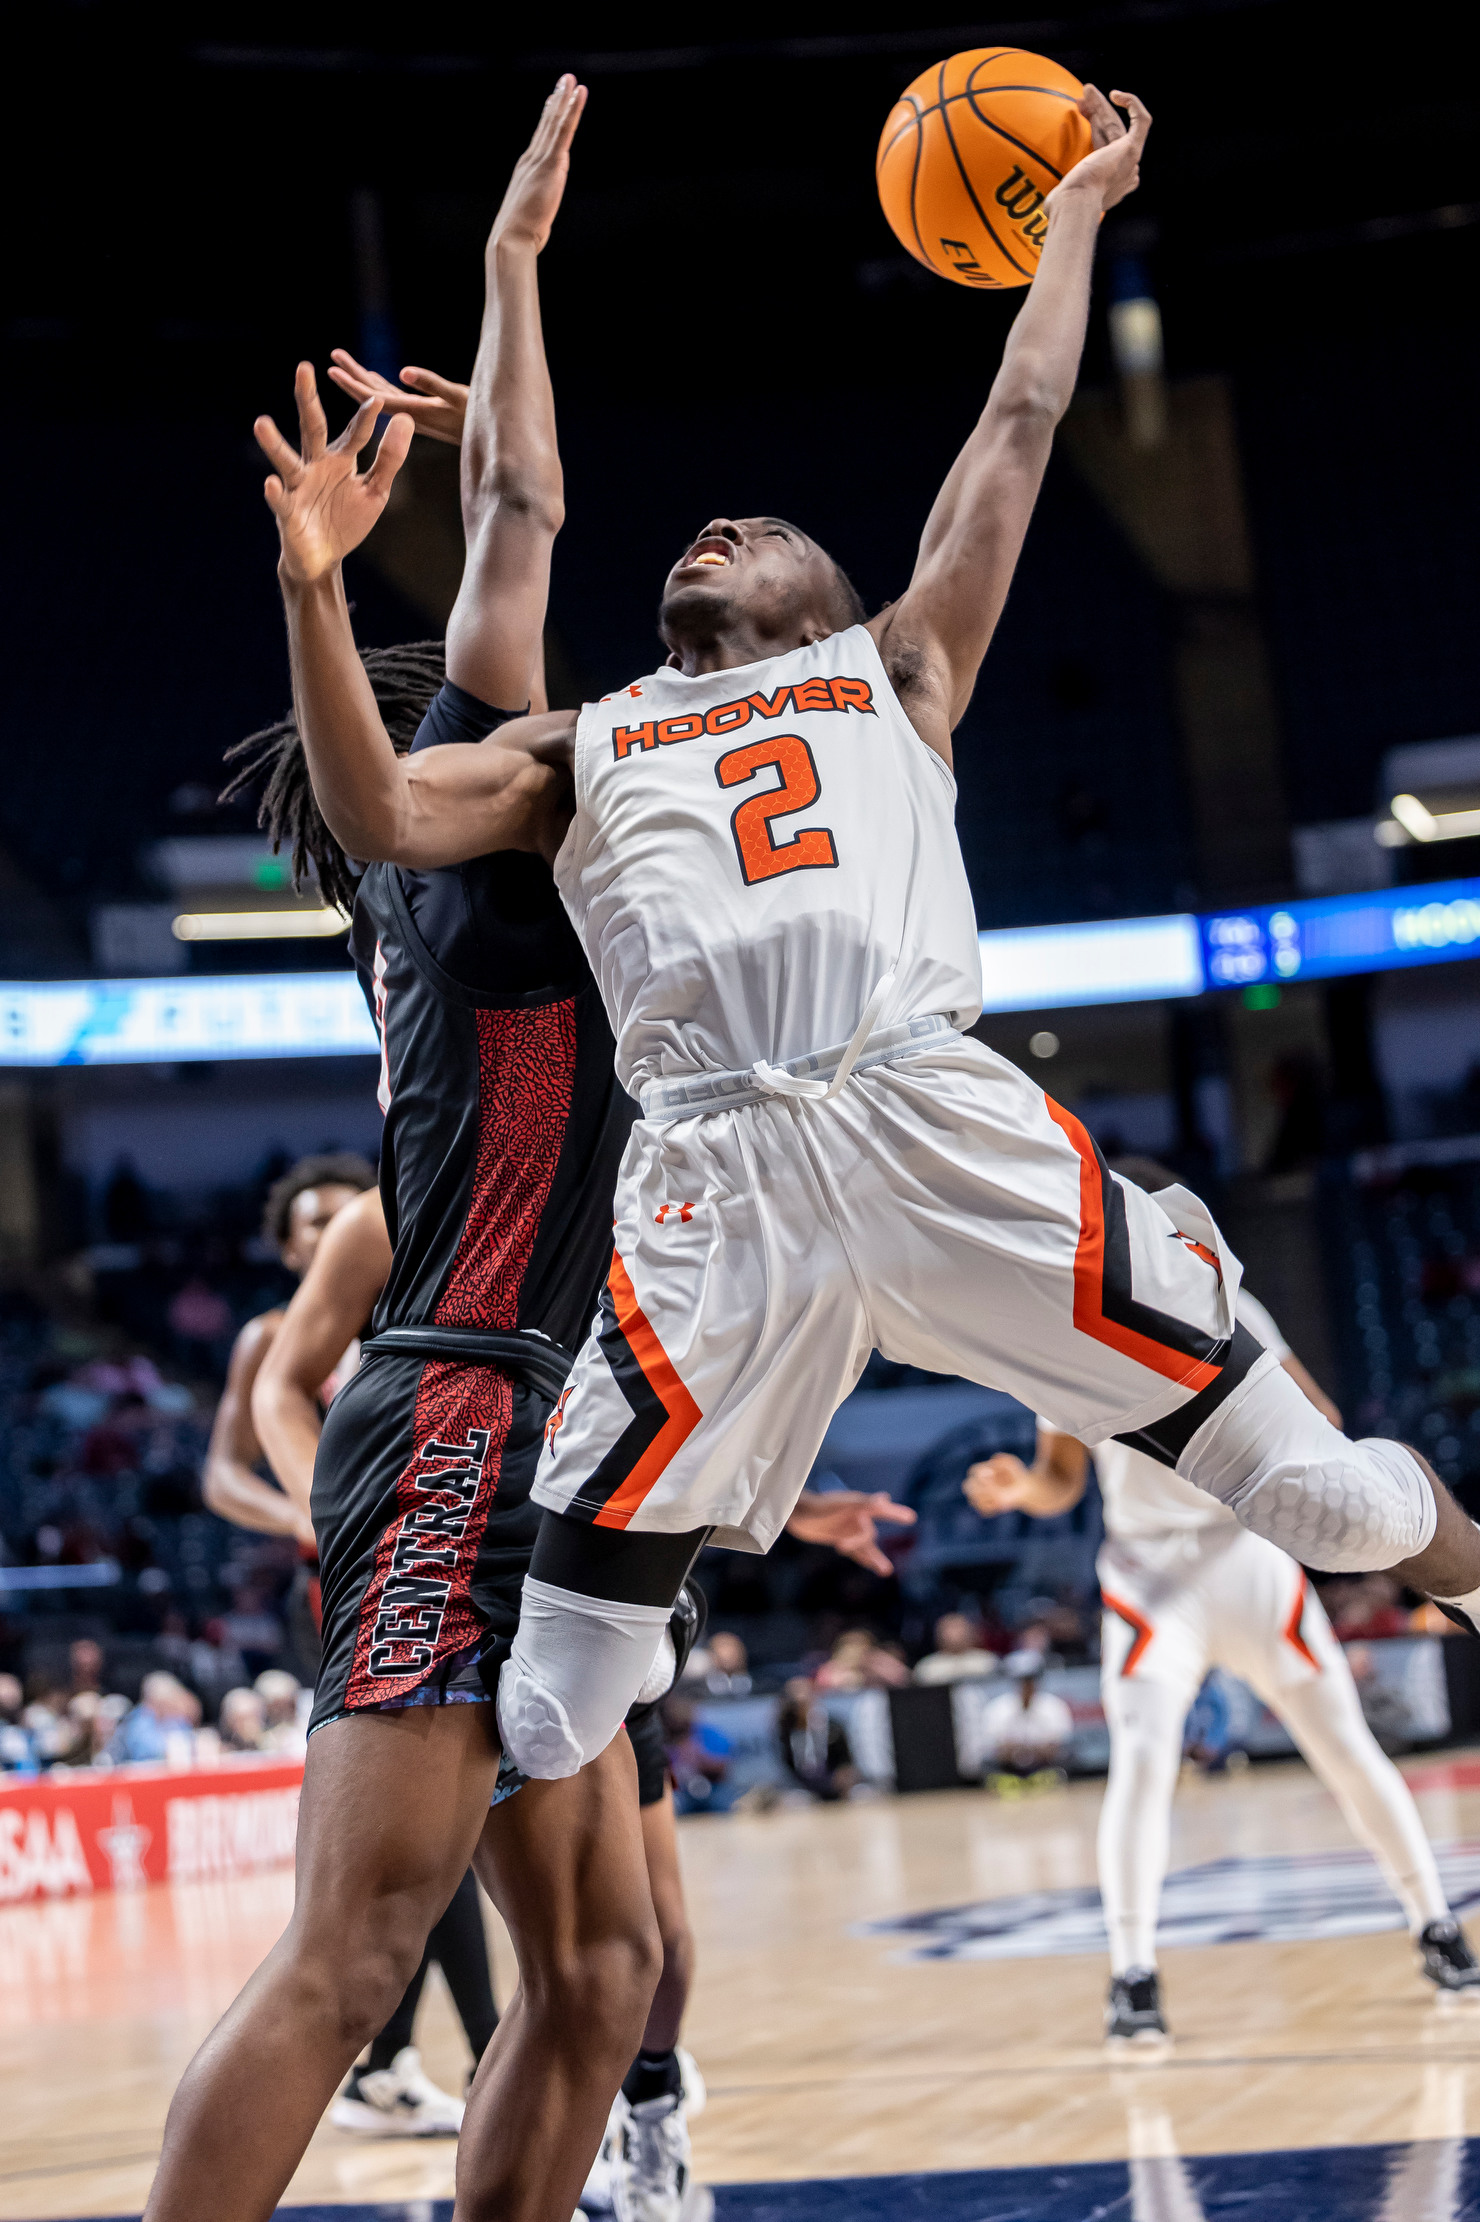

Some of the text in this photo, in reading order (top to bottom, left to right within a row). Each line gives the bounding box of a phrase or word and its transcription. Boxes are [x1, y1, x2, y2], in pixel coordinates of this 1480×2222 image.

[612, 676, 880, 762] HOOVER
[714, 734, 839, 886] 2
[367, 1428, 491, 1678] CENTRAL
